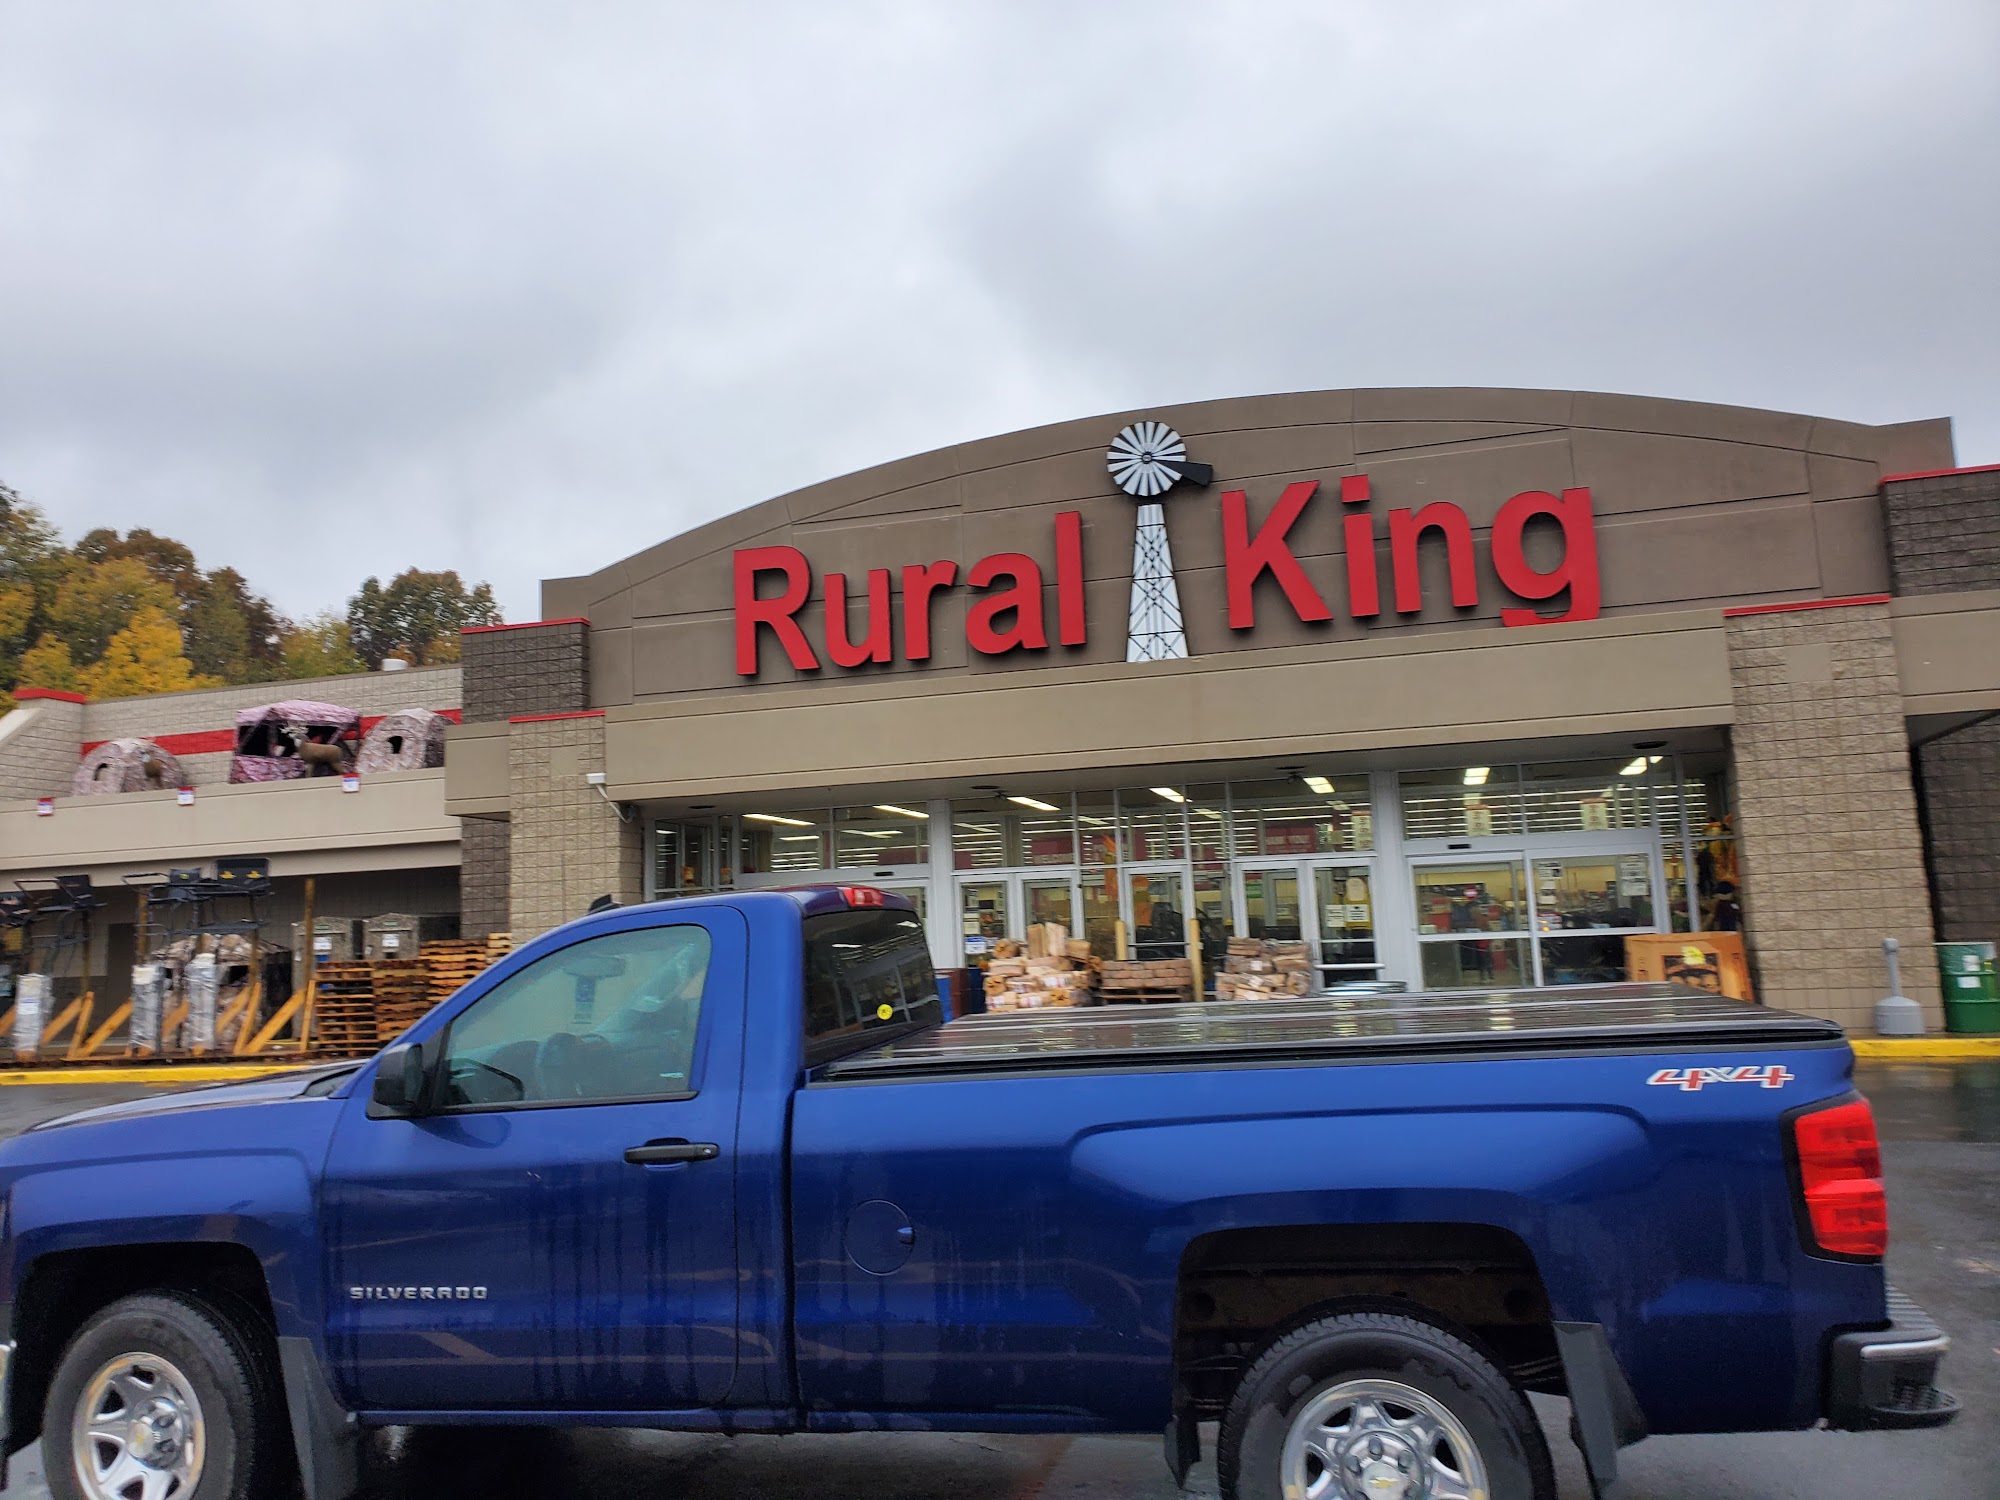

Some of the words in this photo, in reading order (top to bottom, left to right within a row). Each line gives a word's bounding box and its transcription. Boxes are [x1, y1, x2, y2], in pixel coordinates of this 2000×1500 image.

[733, 510, 1088, 675] Rural
[1220, 474, 1601, 630] King
[349, 1285, 489, 1301] SILVERADO
